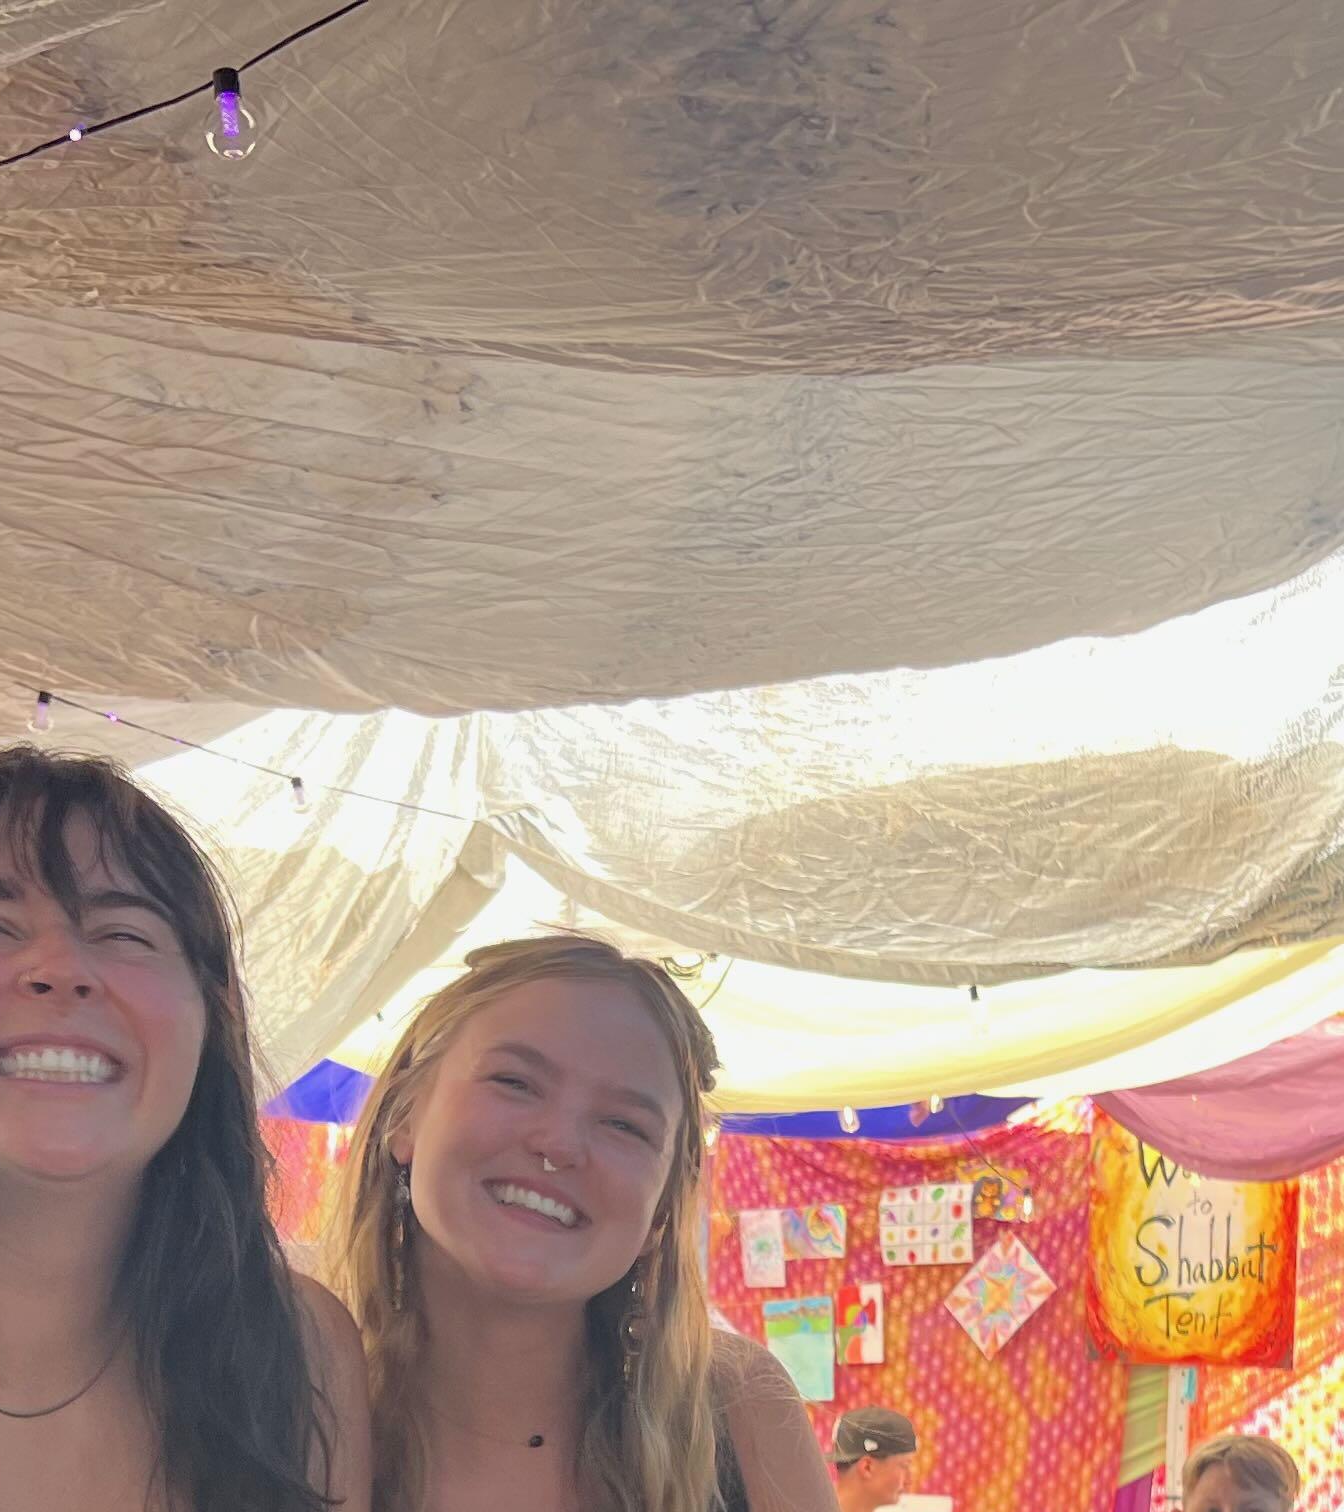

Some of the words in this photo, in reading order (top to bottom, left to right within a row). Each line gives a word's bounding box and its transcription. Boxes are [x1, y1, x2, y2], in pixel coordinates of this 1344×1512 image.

[1187, 1190, 1214, 1217] to
[1134, 1212, 1278, 1288] Shabbat
[1143, 1291, 1233, 1340] Tent
